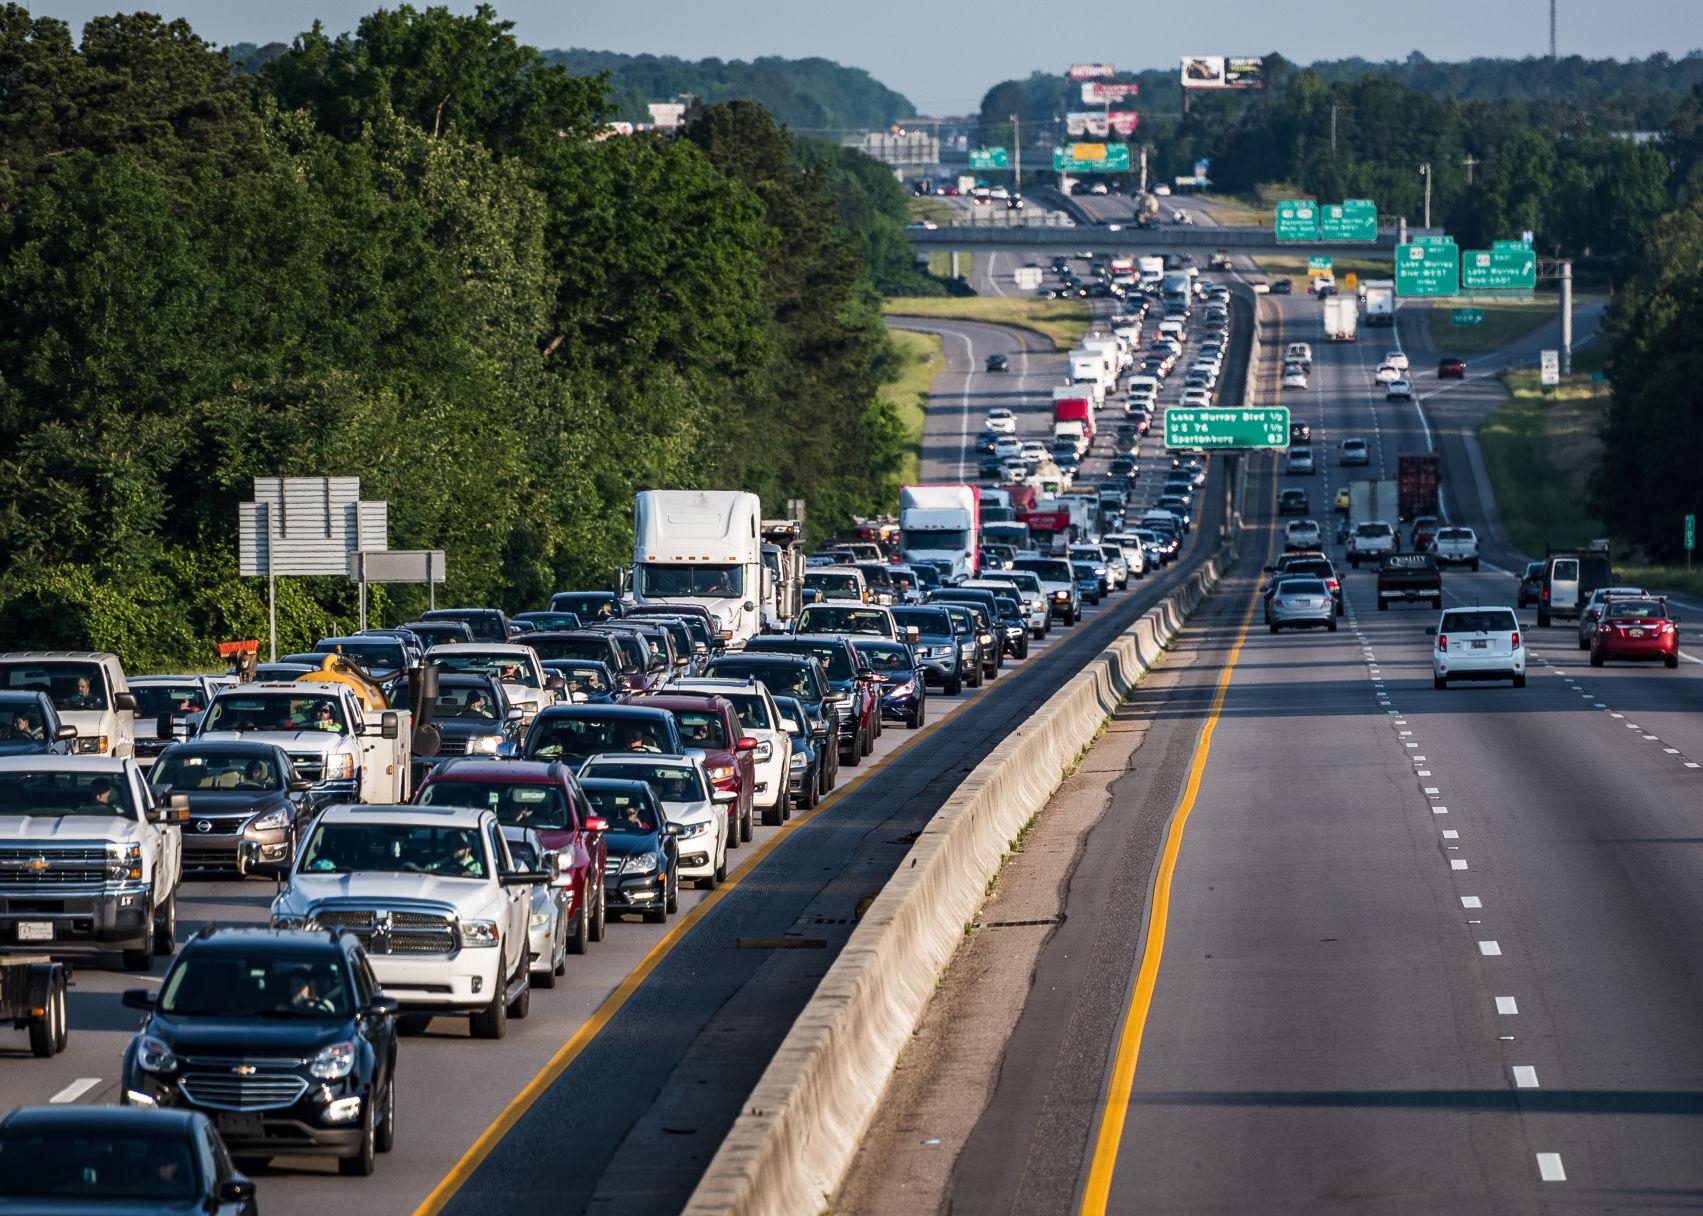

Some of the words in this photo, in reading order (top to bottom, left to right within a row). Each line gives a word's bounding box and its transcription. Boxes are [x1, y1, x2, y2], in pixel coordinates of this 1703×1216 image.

[1170, 412, 1195, 421] Lake
[1200, 412, 1237, 422] Murray
[1242, 411, 1265, 421] Blvd
[1193, 422, 1209, 432] 76
[1171, 434, 1234, 444] Spartanburg
[1390, 555, 1426, 566] QUALITY
